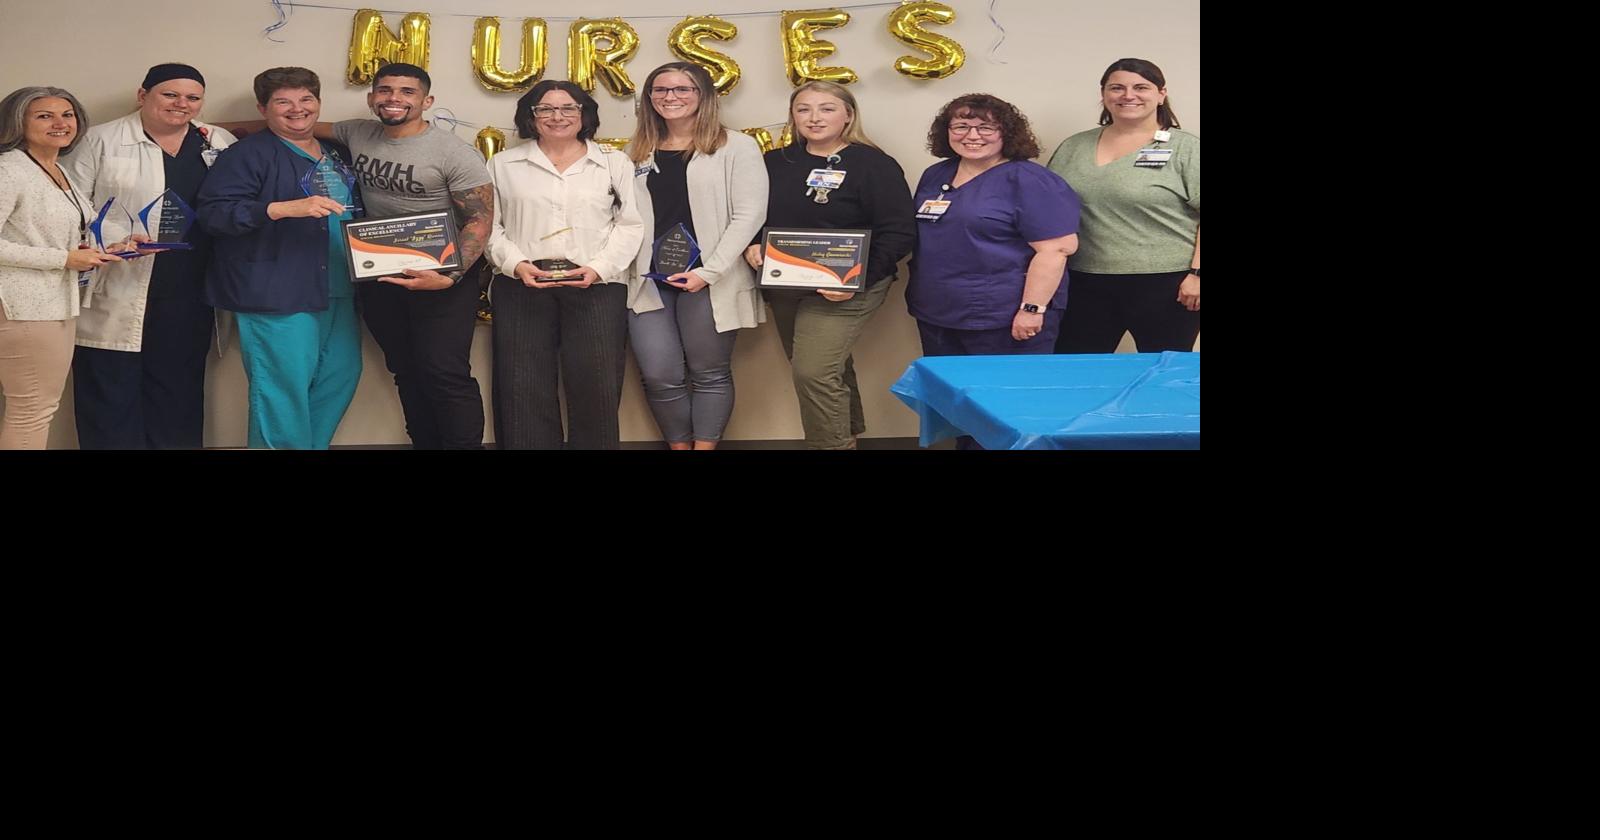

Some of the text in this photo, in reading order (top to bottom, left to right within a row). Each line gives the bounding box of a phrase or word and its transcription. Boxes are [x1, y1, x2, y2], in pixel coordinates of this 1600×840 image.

[346, 1, 965, 97] NURSES
[354, 153, 415, 182] RMH
[354, 169, 426, 194] TRONG
[358, 225, 385, 233] CLINICAL
[368, 228, 405, 236] EXCELLENCE
